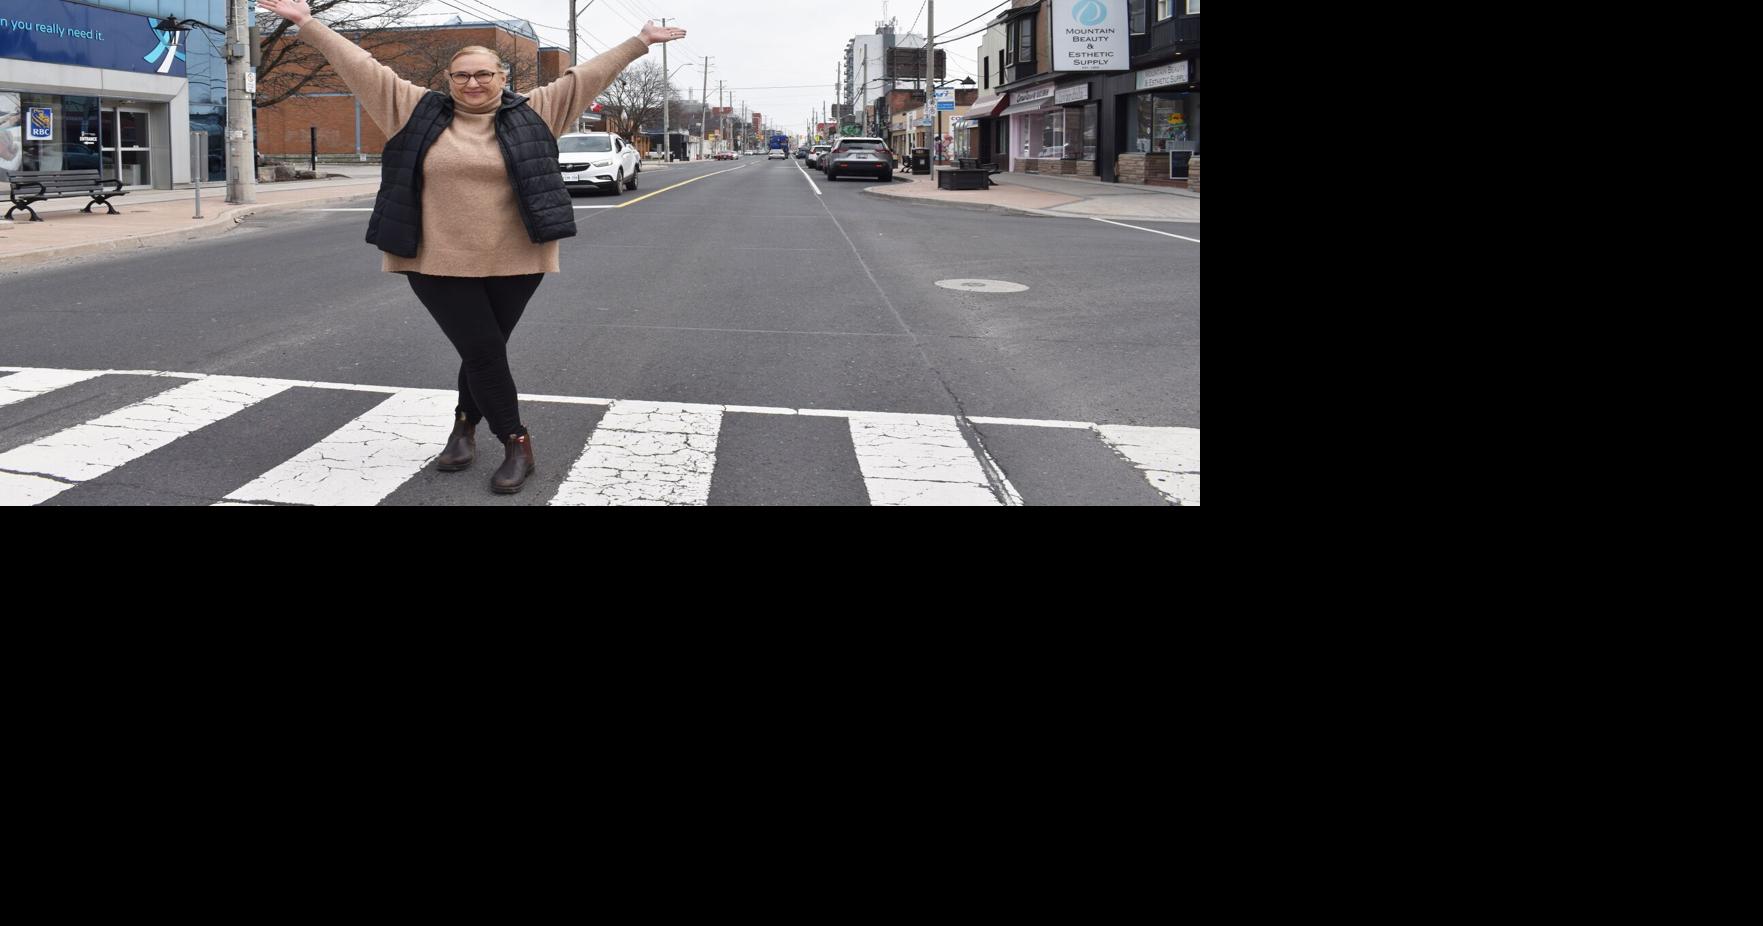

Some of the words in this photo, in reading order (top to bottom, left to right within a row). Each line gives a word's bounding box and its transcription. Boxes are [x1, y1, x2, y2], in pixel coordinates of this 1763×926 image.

[11, 19, 32, 31] you
[35, 23, 65, 37] really
[67, 28, 93, 39] need
[95, 30, 105, 41] it.
[33, 128, 50, 136] RBC
